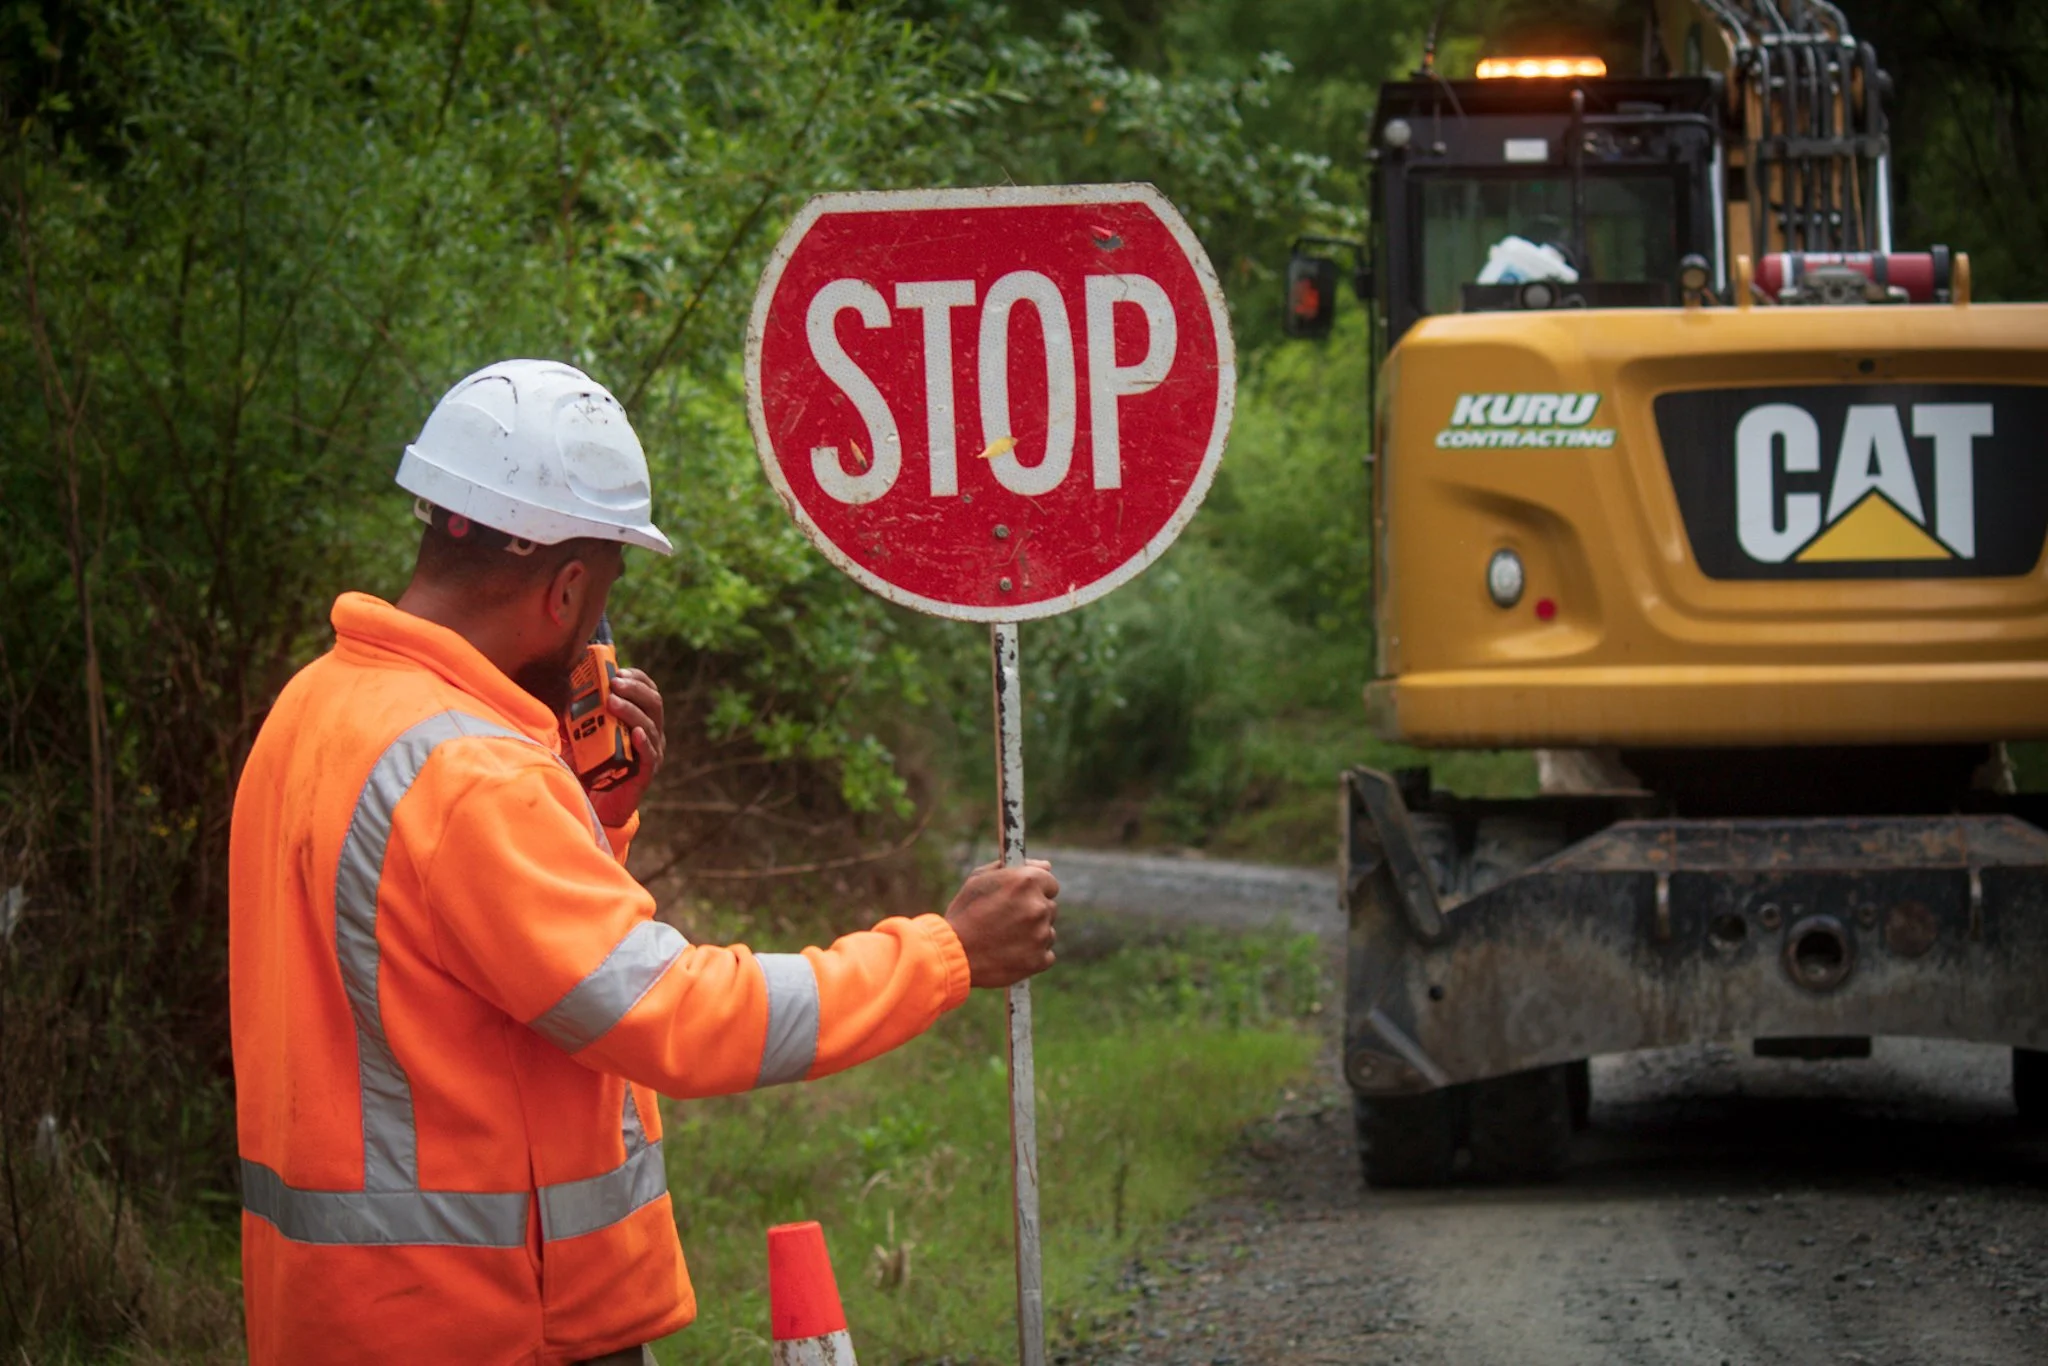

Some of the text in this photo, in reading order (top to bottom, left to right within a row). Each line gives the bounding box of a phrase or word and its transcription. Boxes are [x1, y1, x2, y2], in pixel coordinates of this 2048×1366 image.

[806, 269, 1178, 505] STOP
[1452, 393, 1600, 426] KURU
[1435, 429, 1616, 448] CONTRACTING
[1735, 403, 1994, 563] CAT
